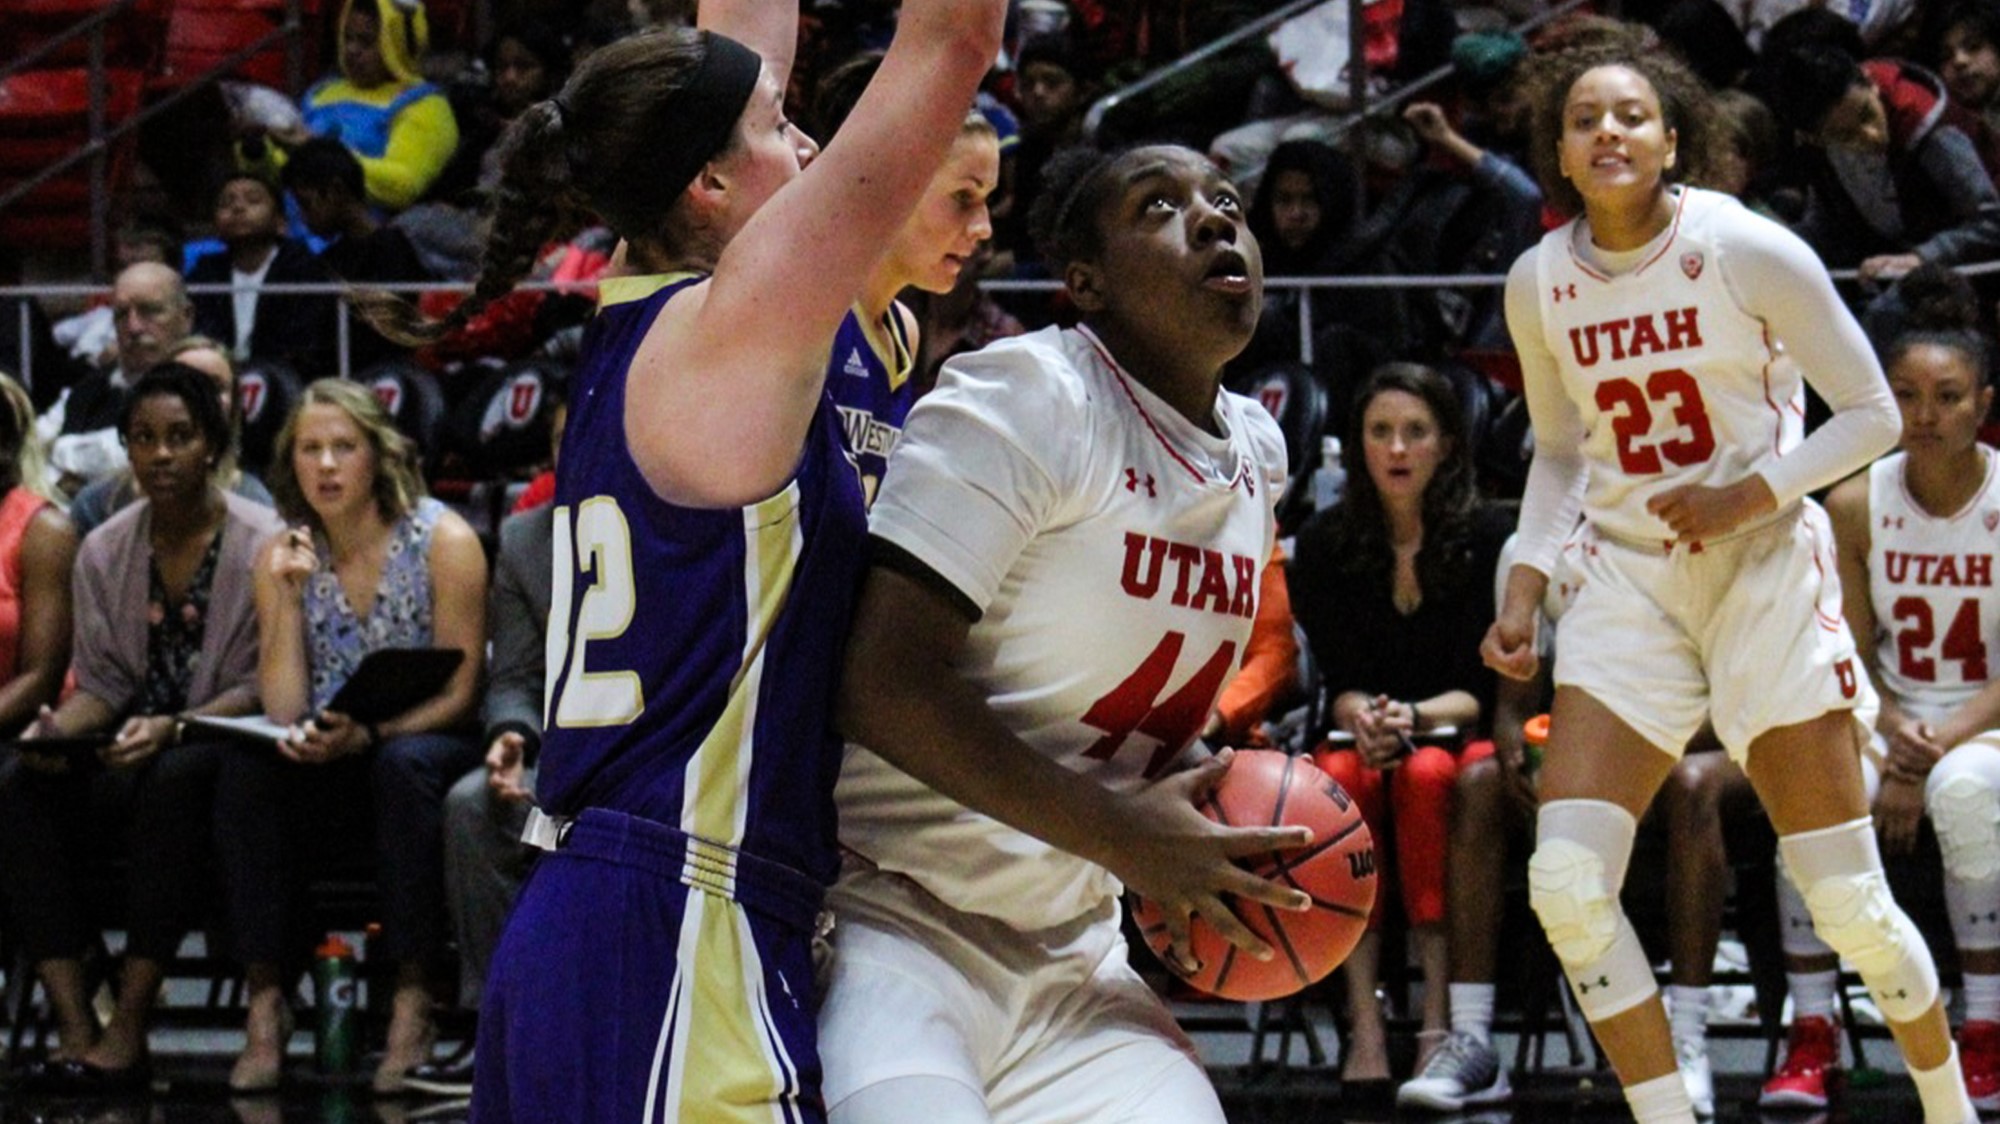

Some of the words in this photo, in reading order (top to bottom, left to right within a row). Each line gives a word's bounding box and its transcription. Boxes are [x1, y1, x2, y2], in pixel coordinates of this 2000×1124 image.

[1569, 306, 1704, 367] UTAH
[510, 382, 535, 420] U
[1595, 368, 1716, 475] 23
[1120, 531, 1255, 619] UTAH
[1885, 551, 1993, 587] UTAH
[1892, 596, 1988, 682] 24
[1079, 630, 1236, 780] 44
[1834, 658, 1857, 700] U
